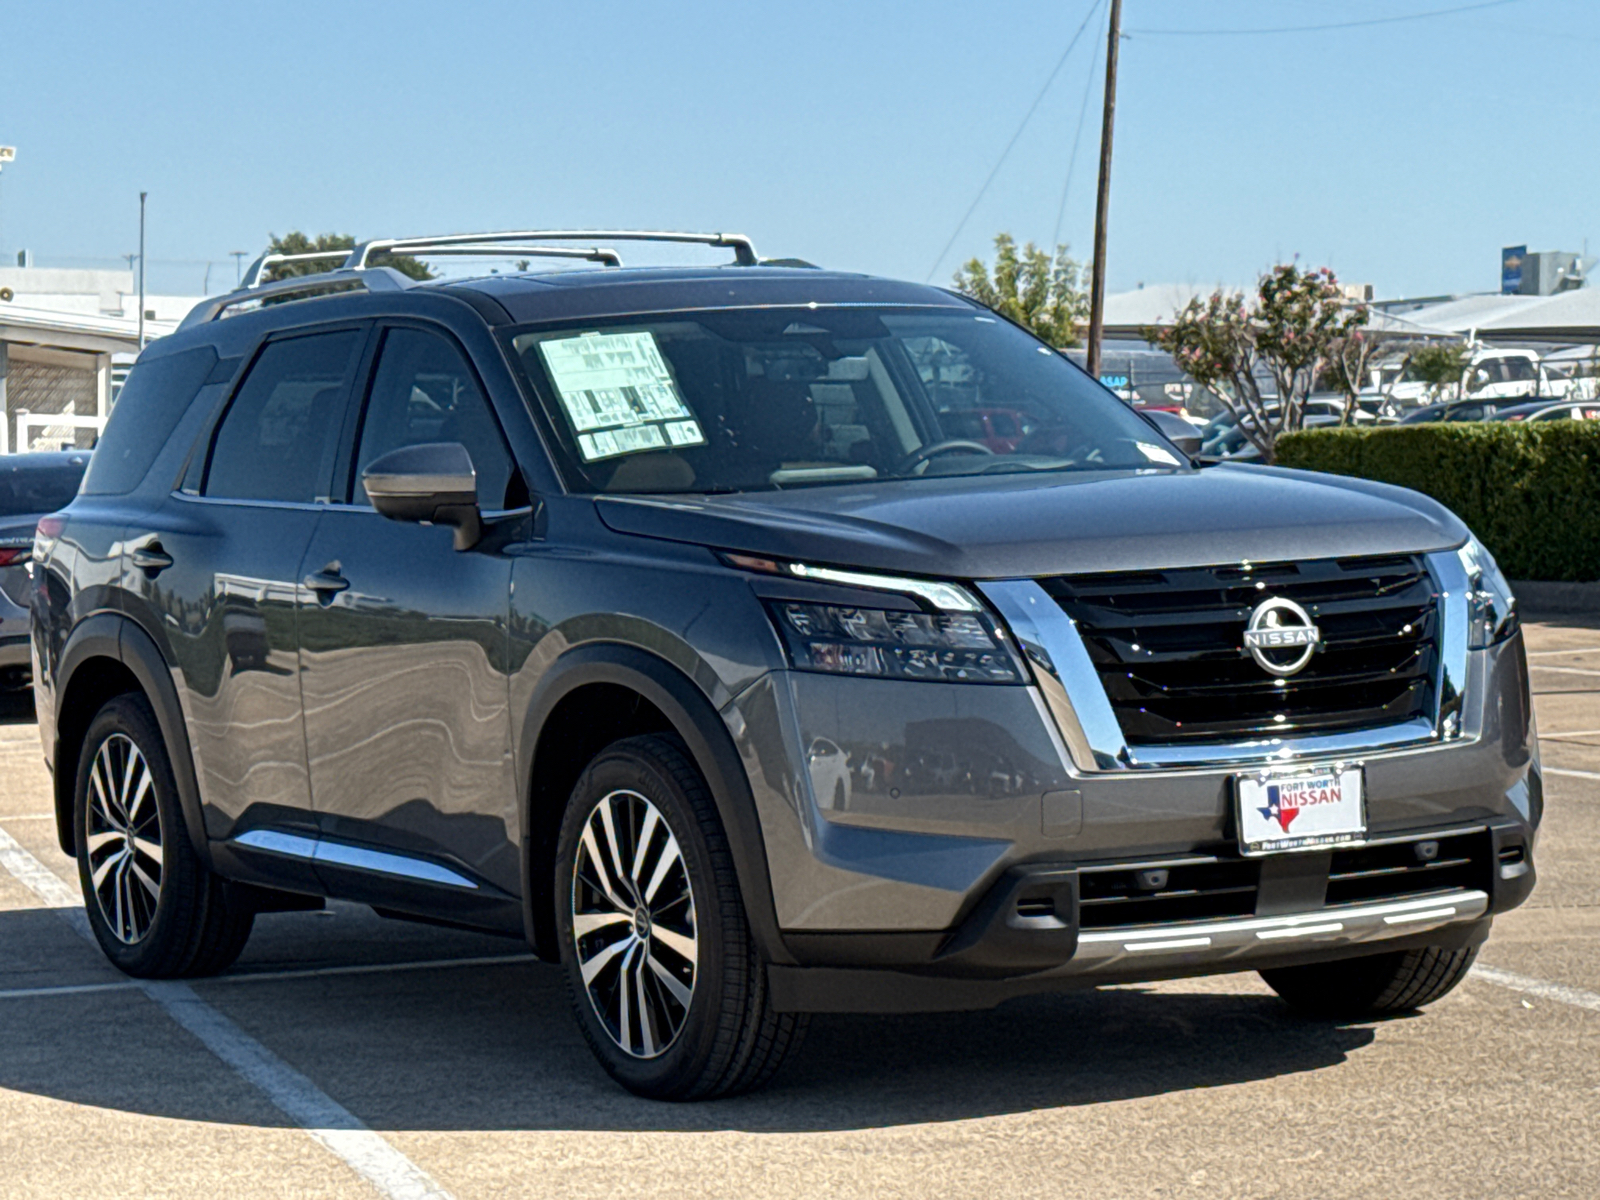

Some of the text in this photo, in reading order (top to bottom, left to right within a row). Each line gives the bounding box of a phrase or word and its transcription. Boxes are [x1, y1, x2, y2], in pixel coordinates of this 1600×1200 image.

[1245, 630, 1318, 646] NISSAN
[1281, 778, 1340, 793] FORT WORTH
[1281, 787, 1342, 807] NISSAN
